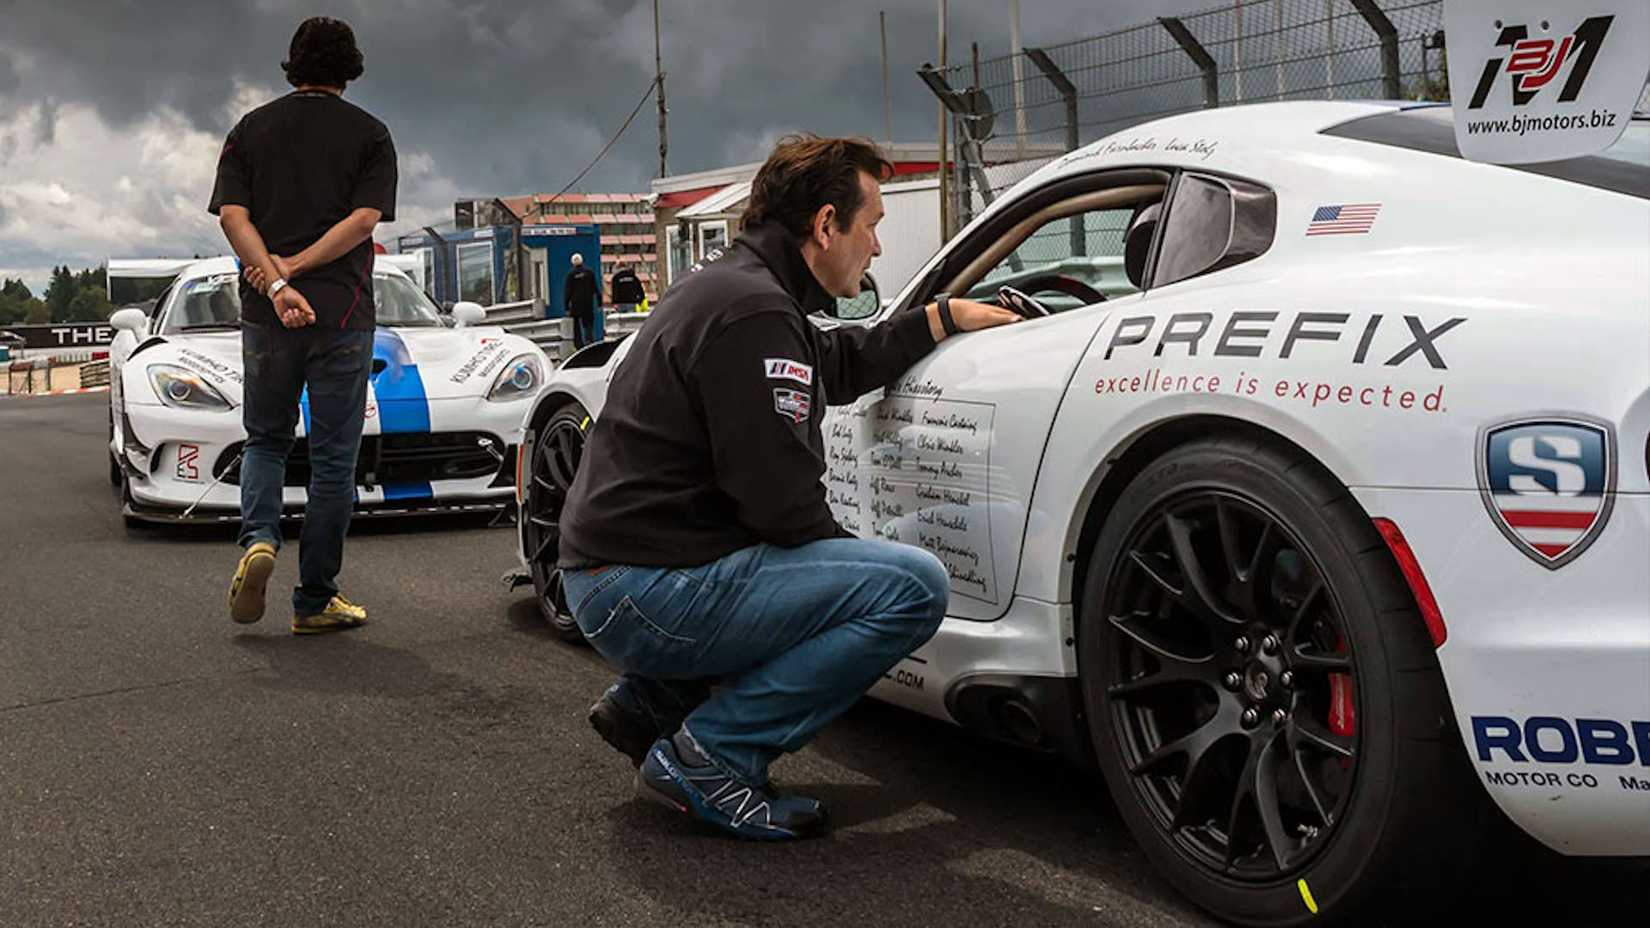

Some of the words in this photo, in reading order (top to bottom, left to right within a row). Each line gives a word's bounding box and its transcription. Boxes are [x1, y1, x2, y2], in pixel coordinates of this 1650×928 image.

[1467, 109, 1616, 136] www.bjmotors.biz
[51, 327, 112, 344] THE
[1104, 312, 1468, 369] PREFIX
[1095, 369, 1220, 394] excellence
[1235, 372, 1258, 394] is
[1485, 771, 1562, 786] MOTOR
[1567, 774, 1598, 788] CO
